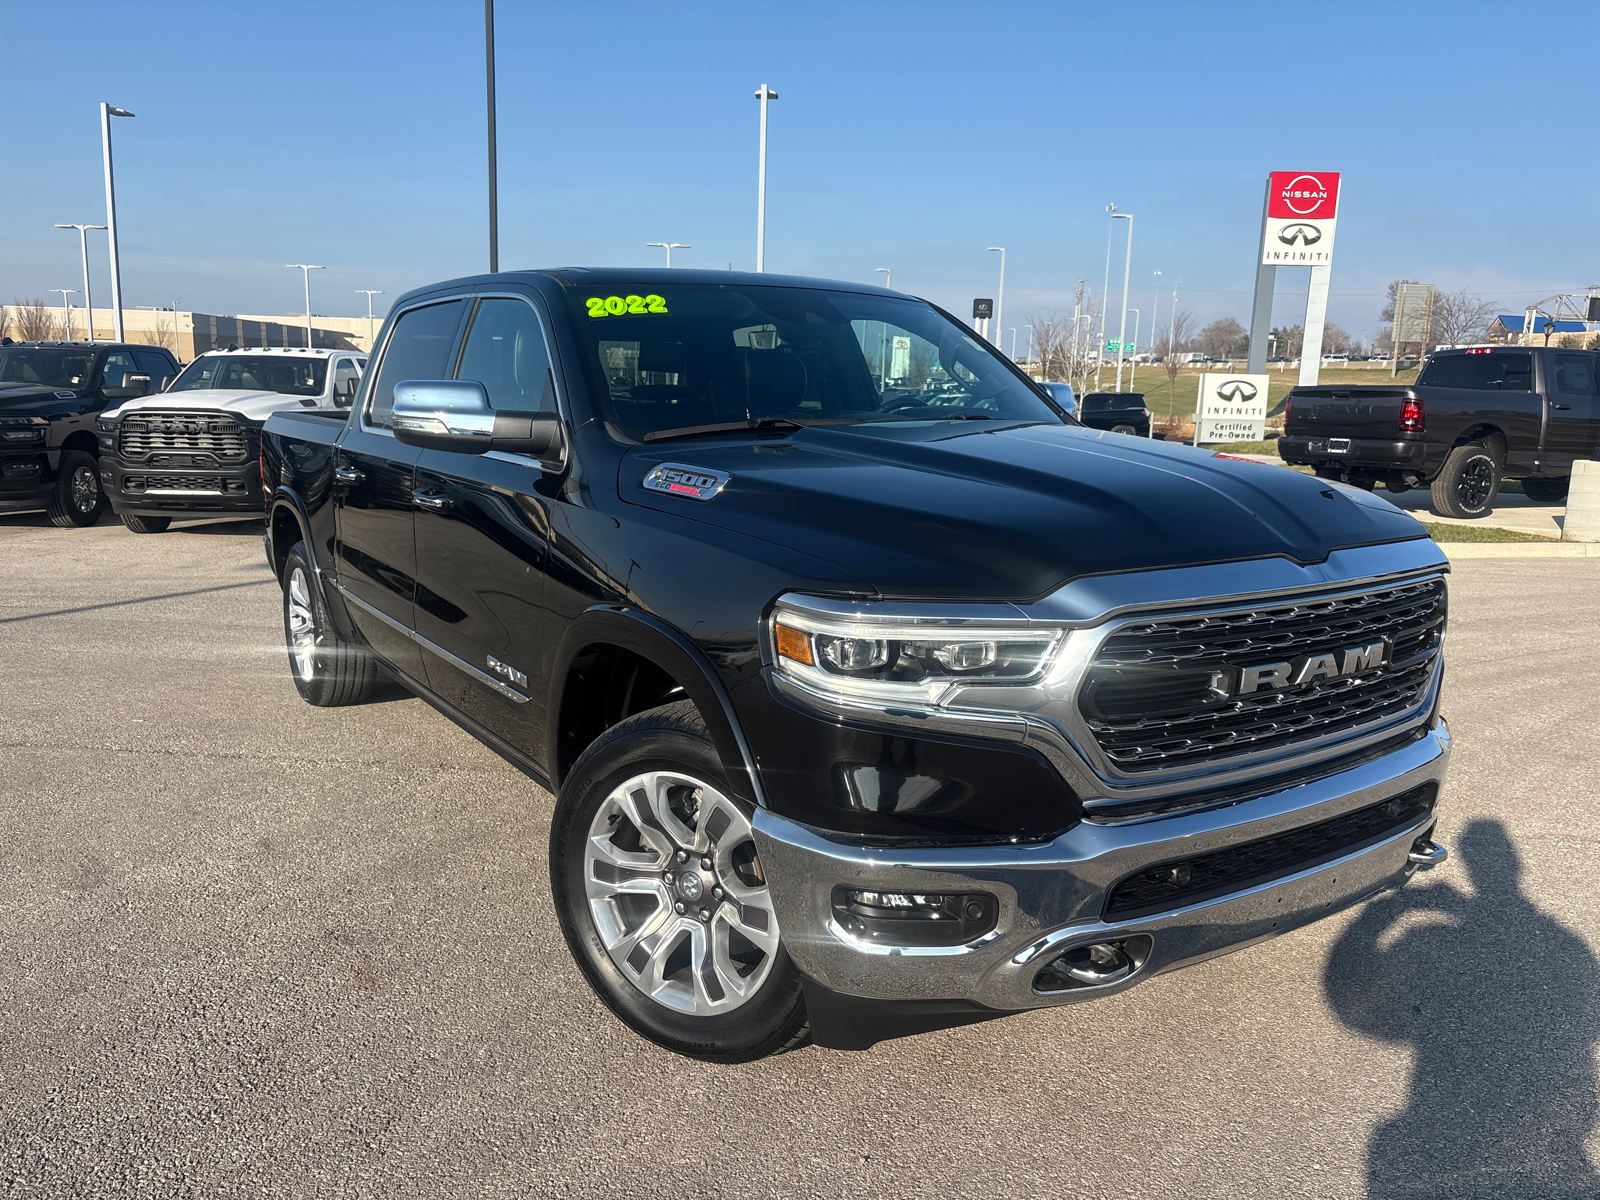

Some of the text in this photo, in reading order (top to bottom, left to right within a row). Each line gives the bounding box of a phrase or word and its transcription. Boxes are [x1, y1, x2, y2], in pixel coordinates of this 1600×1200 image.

[1281, 190, 1328, 199] NISSAN
[1266, 251, 1329, 261] INFINITI
[585, 294, 669, 318] 2022
[1207, 407, 1263, 416] INFINITI
[1214, 422, 1253, 432] Certified
[1209, 431, 1256, 440] Pre-Owned
[656, 468, 717, 489] 1500
[486, 654, 528, 689] RAM
[1238, 641, 1385, 695] RAM
